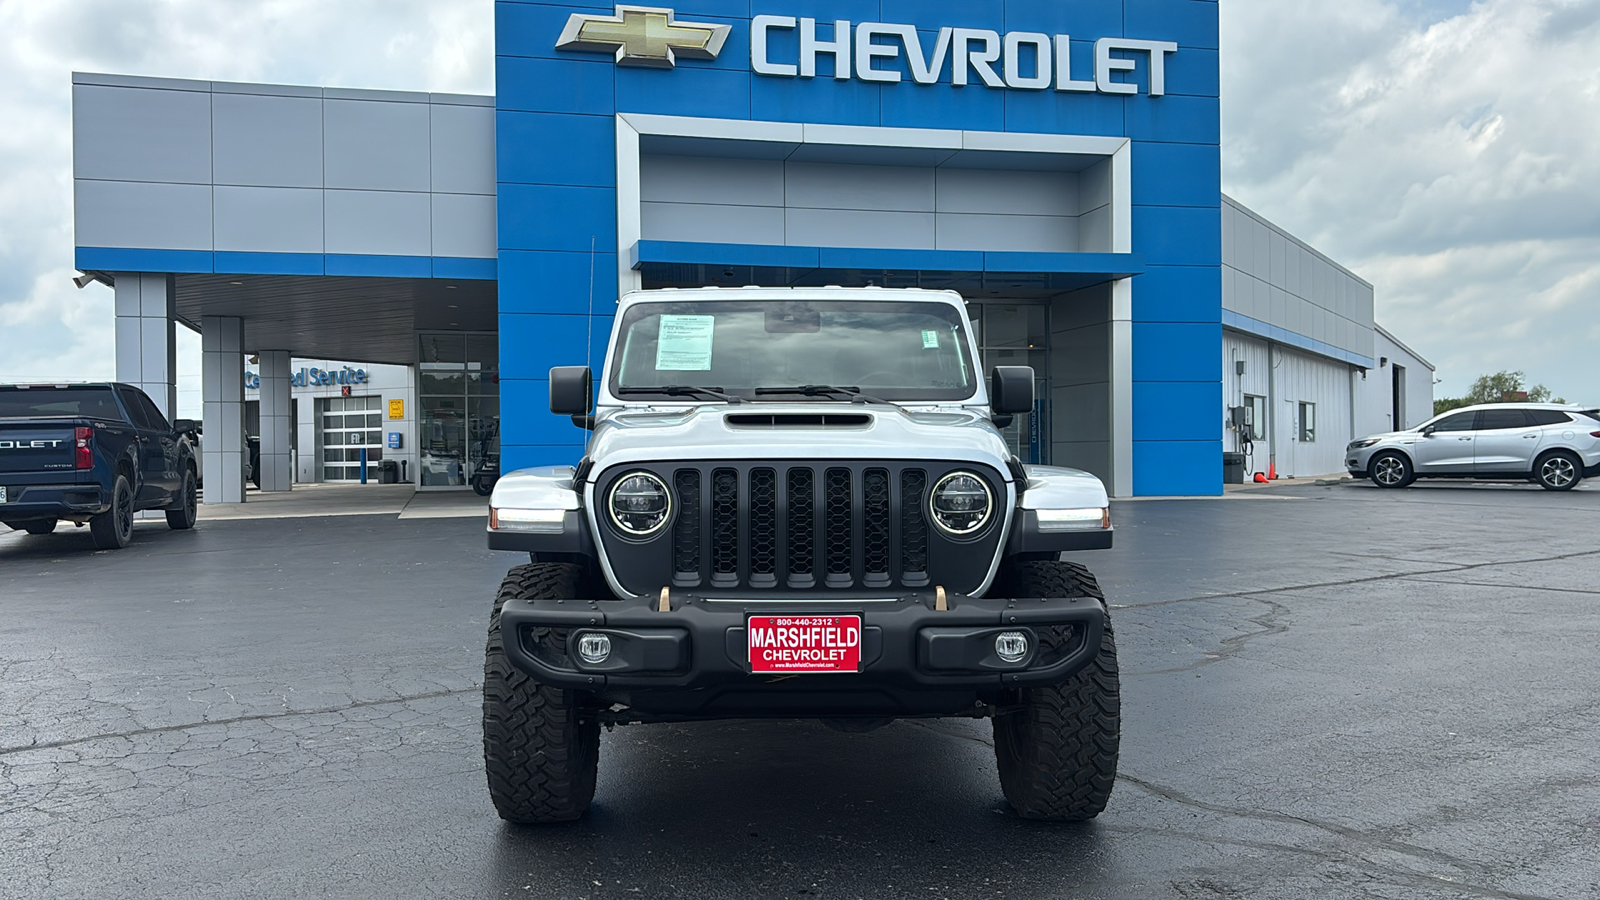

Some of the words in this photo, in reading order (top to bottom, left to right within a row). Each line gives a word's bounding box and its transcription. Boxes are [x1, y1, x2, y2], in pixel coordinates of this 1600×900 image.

[750, 14, 1178, 97] CHEVROLET
[309, 365, 367, 387] Service
[776, 618, 833, 626] 800-440-2312
[751, 627, 858, 648] MARSHFIELD
[762, 649, 847, 661] CHEVROLET
[774, 661, 835, 669] www.MarshfieldChevrolet.com
